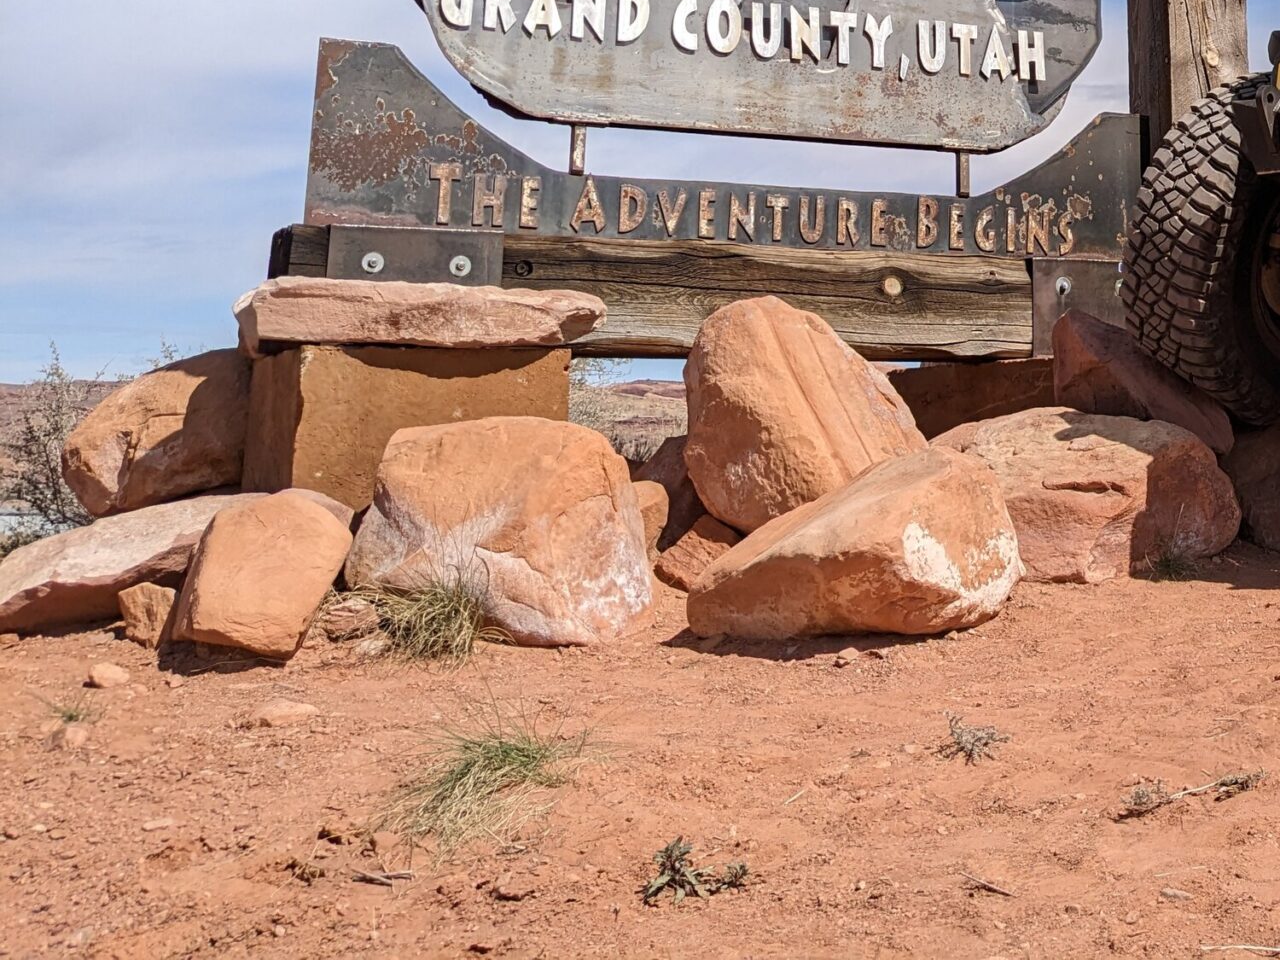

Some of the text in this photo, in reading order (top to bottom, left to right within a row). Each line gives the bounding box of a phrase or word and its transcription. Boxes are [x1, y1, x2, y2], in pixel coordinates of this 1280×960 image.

[917, 19, 1047, 82] UTAH
[428, 162, 1074, 257] THE ADVENTURE BEGINS
